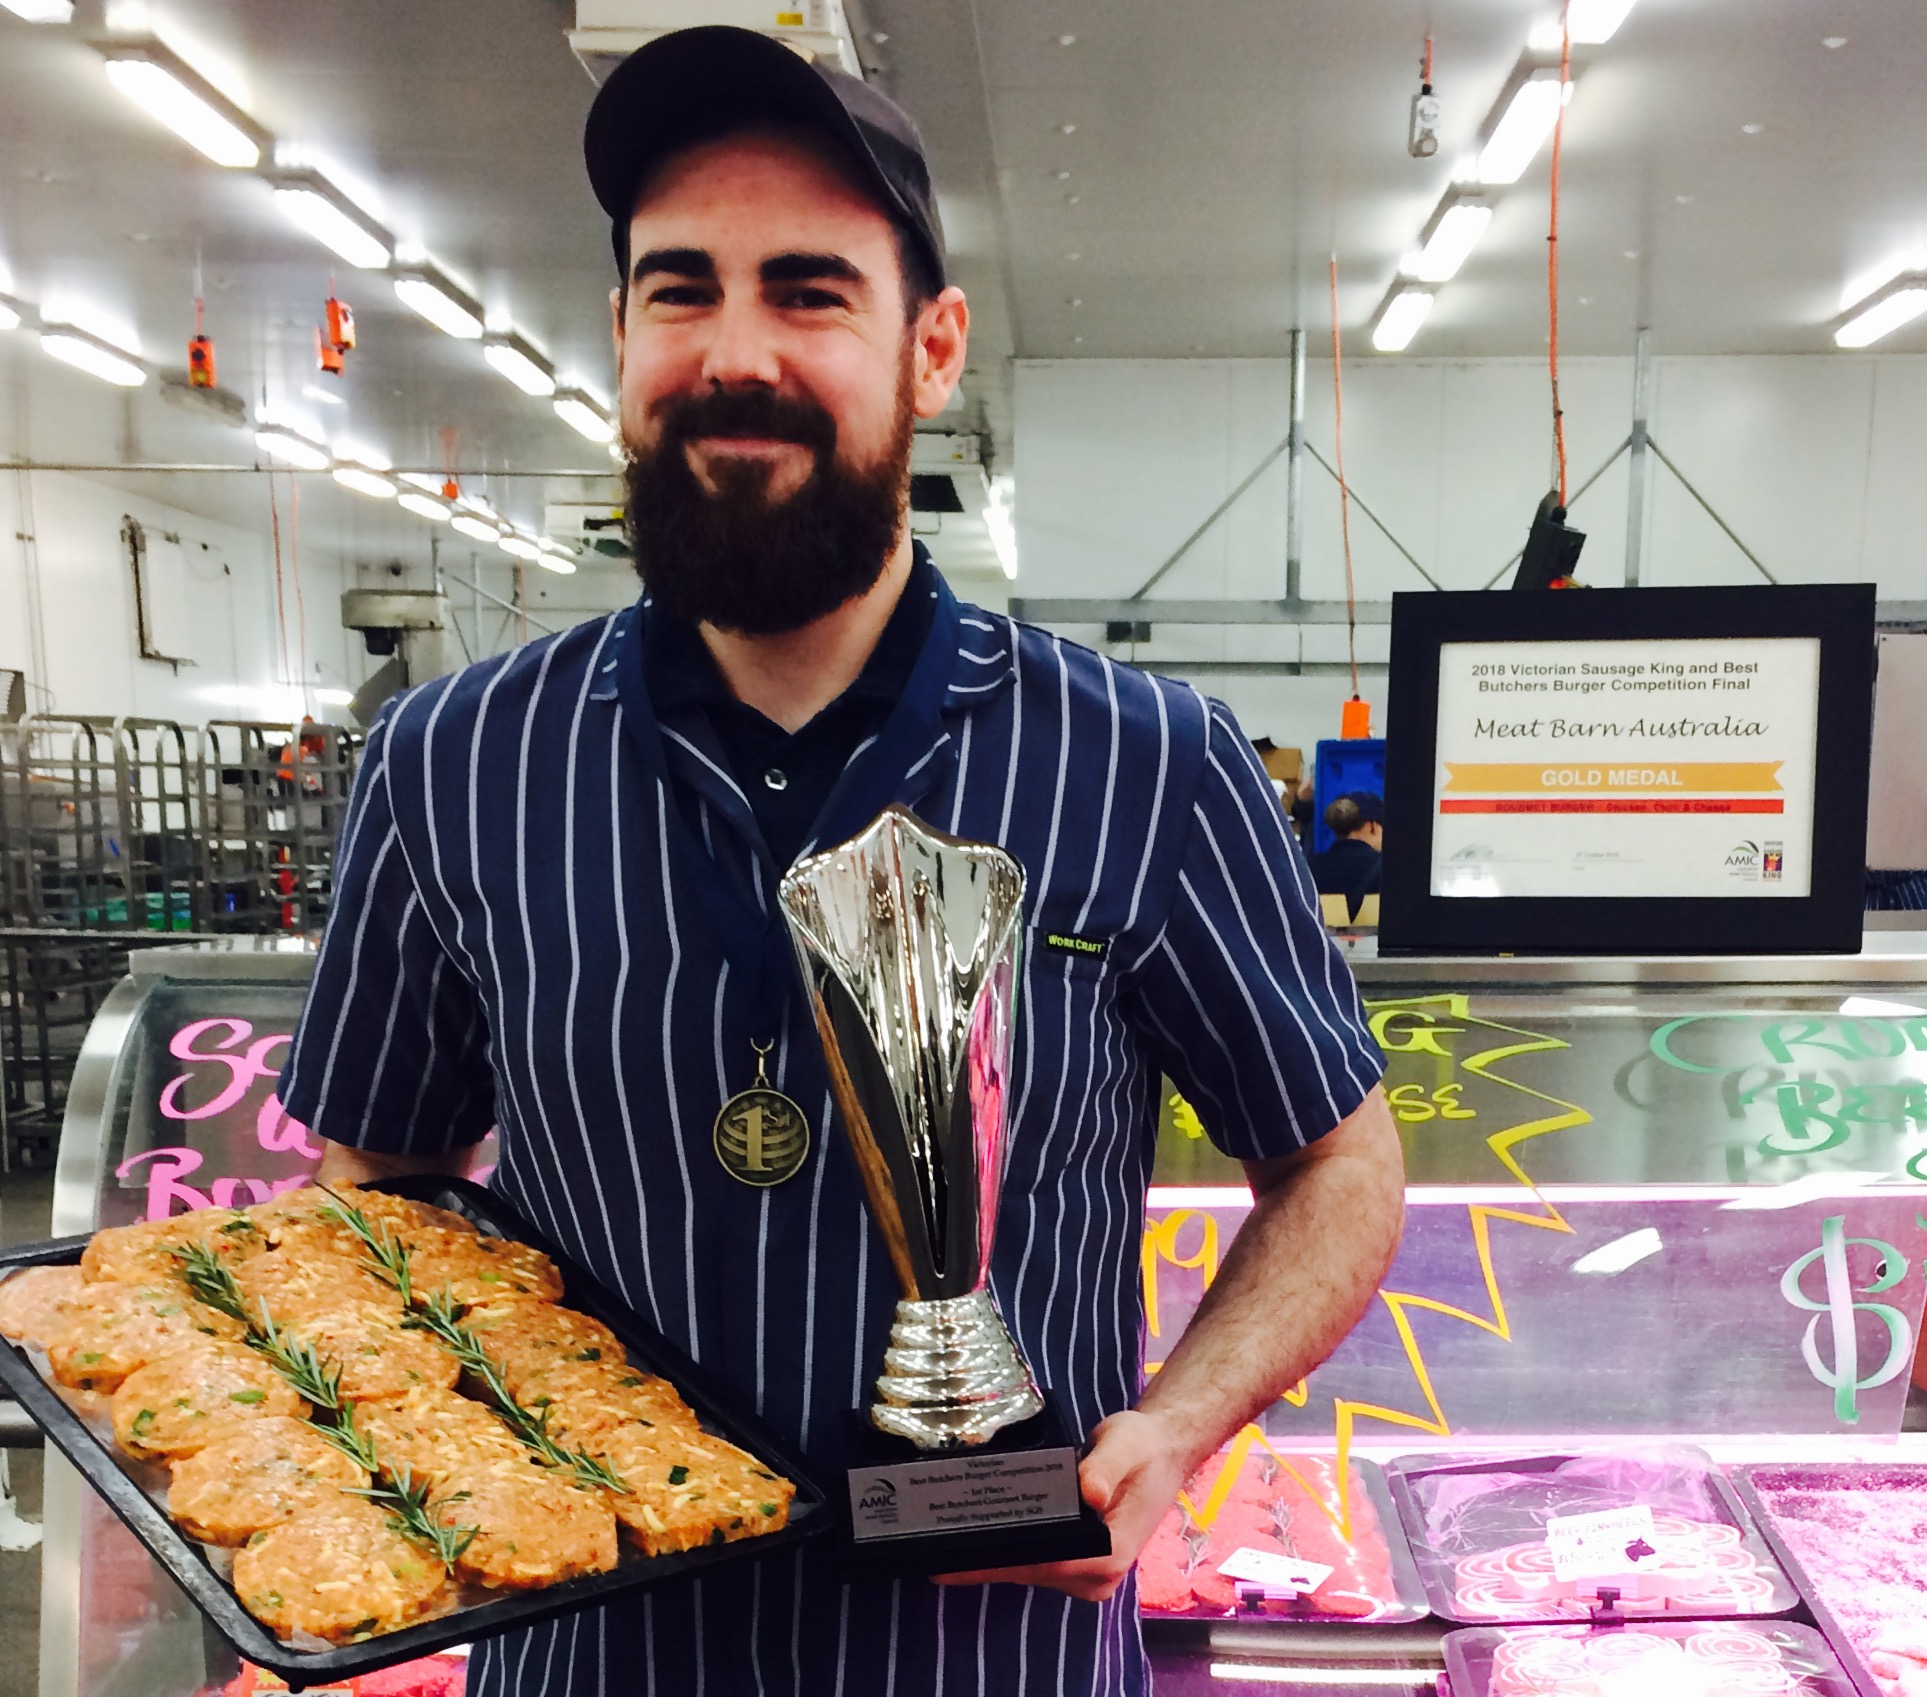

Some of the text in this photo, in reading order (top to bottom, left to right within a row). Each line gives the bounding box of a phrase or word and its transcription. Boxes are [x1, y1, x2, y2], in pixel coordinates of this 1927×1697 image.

[1471, 661, 1759, 677] 2018 Victorian Sausage King and Best
[1478, 678, 1750, 694] Butchers Burger Competition Final
[1474, 715, 1769, 739] Meat Barn Australia
[1541, 769, 1683, 786] GOLD MEDAL
[1724, 855, 1759, 866] AMIC
[1048, 935, 1102, 953] WORK CRAFT
[964, 1470, 992, 1480] Burger
[993, 1466, 1044, 1478] Competition
[984, 1485, 1005, 1494] Place
[1021, 1493, 1048, 1502] Burger
[859, 1494, 897, 1510] AMIC
